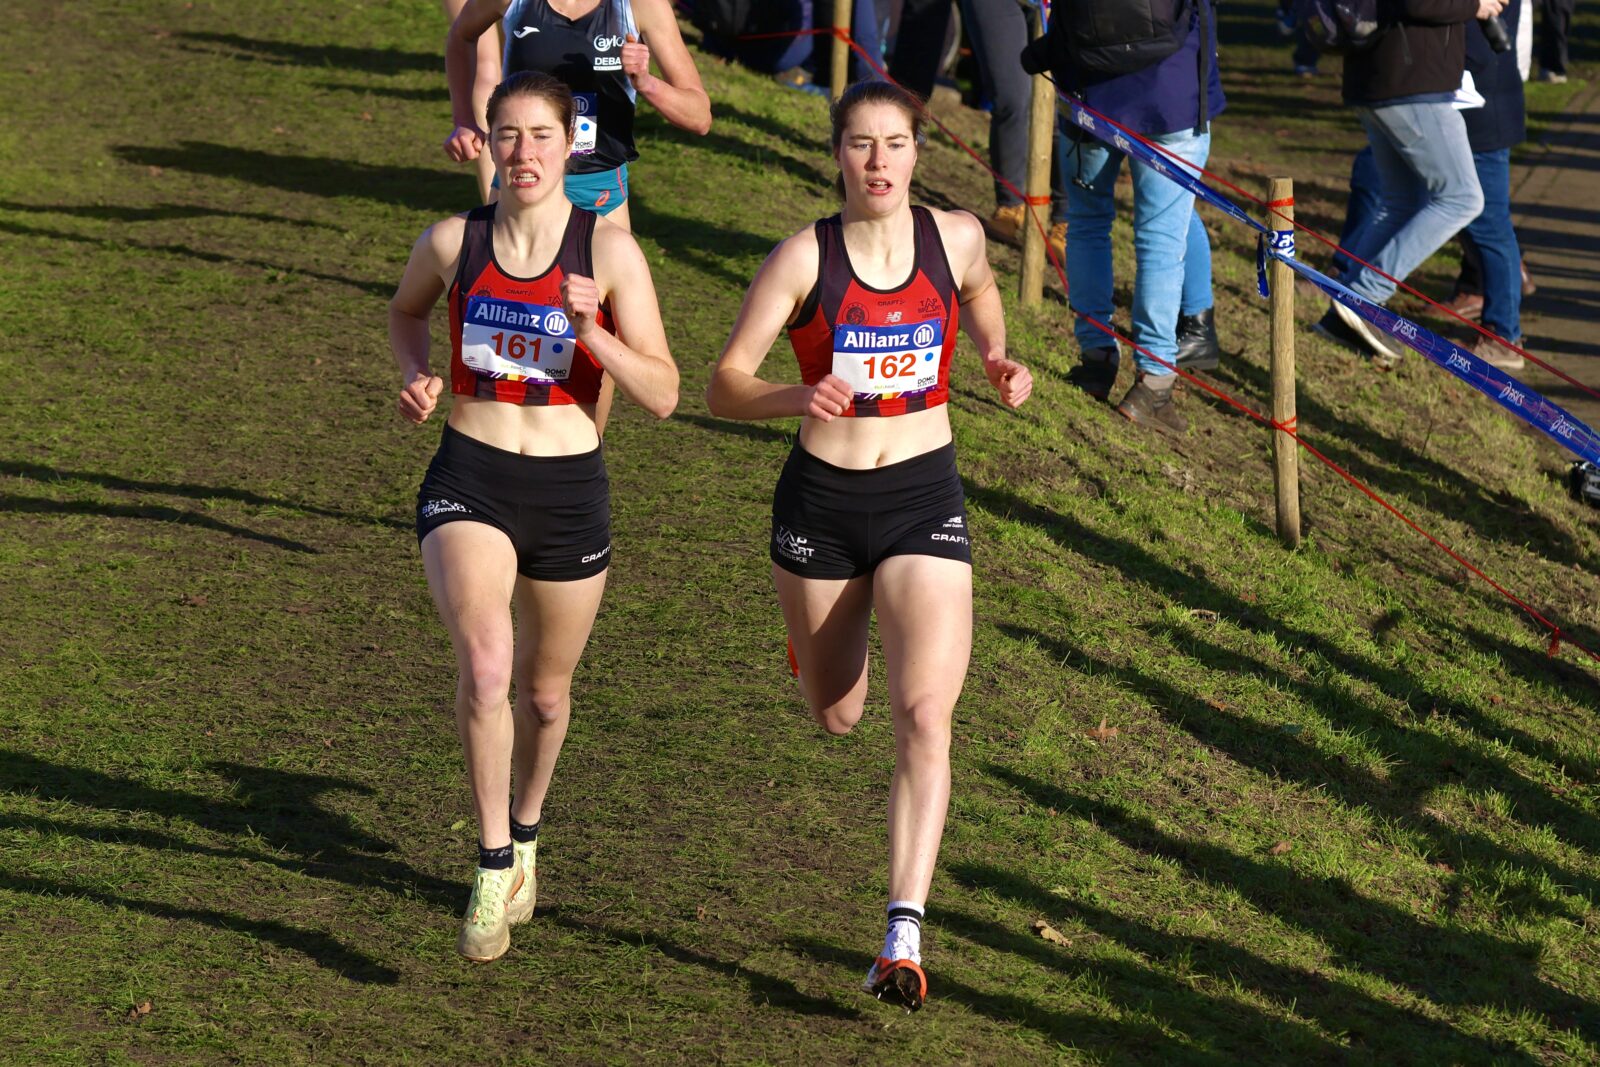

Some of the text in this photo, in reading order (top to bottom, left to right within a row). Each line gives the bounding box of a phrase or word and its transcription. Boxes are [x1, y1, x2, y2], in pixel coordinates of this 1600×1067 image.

[474, 302, 541, 328] Allianz
[491, 331, 542, 363] 161
[843, 331, 910, 348] Allianz
[863, 352, 917, 380] 162
[917, 375, 935, 385] DOMO
[930, 533, 965, 544] CRAFT
[581, 547, 609, 563] CRAFT
